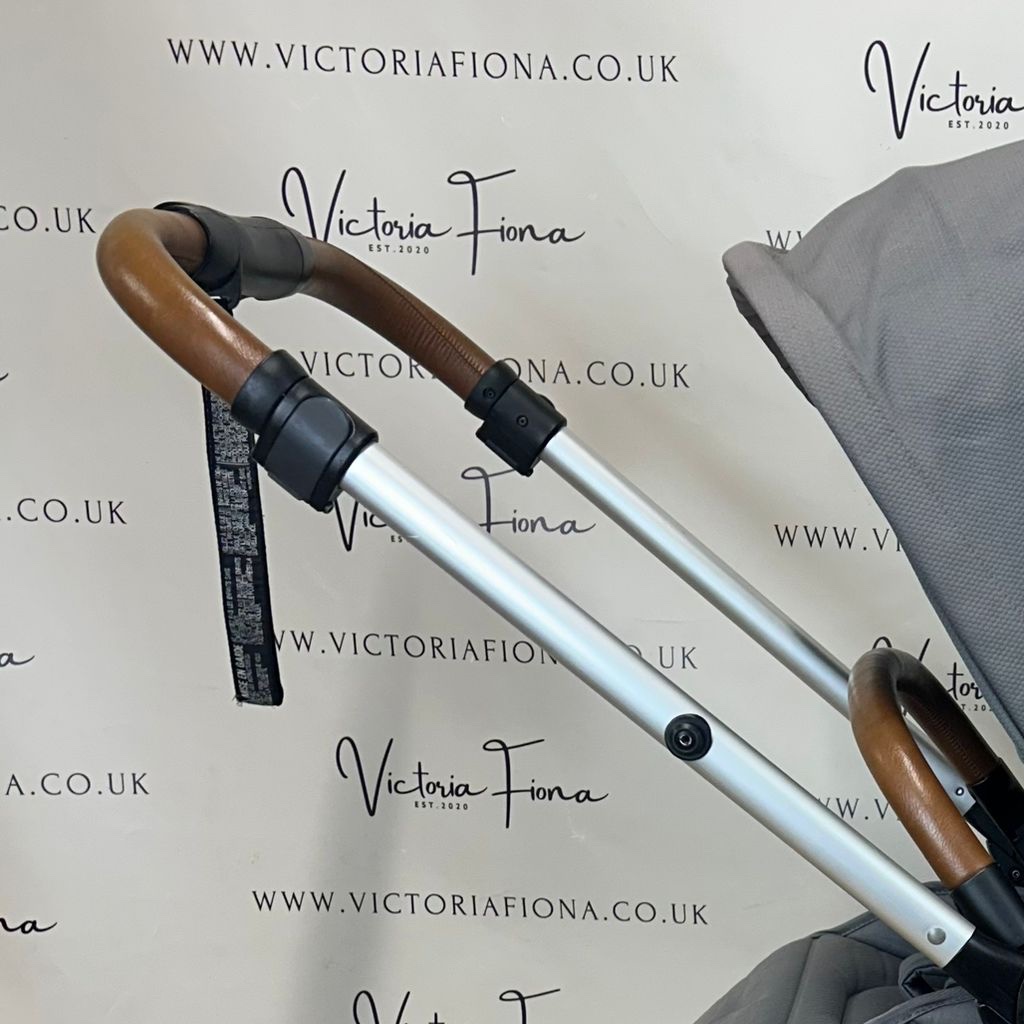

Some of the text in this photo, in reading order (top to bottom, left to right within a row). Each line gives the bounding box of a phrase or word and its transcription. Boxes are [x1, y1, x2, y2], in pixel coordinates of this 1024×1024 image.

[167, 38, 678, 82] WWW.VICTORIAFIONA.CO.UK
[948, 120, 1009, 130] EST.2020
[281, 167, 585, 275] Victoria Fiona
[369, 244, 429, 254] EST.2020
[461, 467, 597, 534] Fiona
[336, 736, 608, 829] Victoria Fiona
[415, 801, 468, 810] EST.2020
[252, 890, 709, 926] WWW.VICTORIAFIONA.CO.UK
